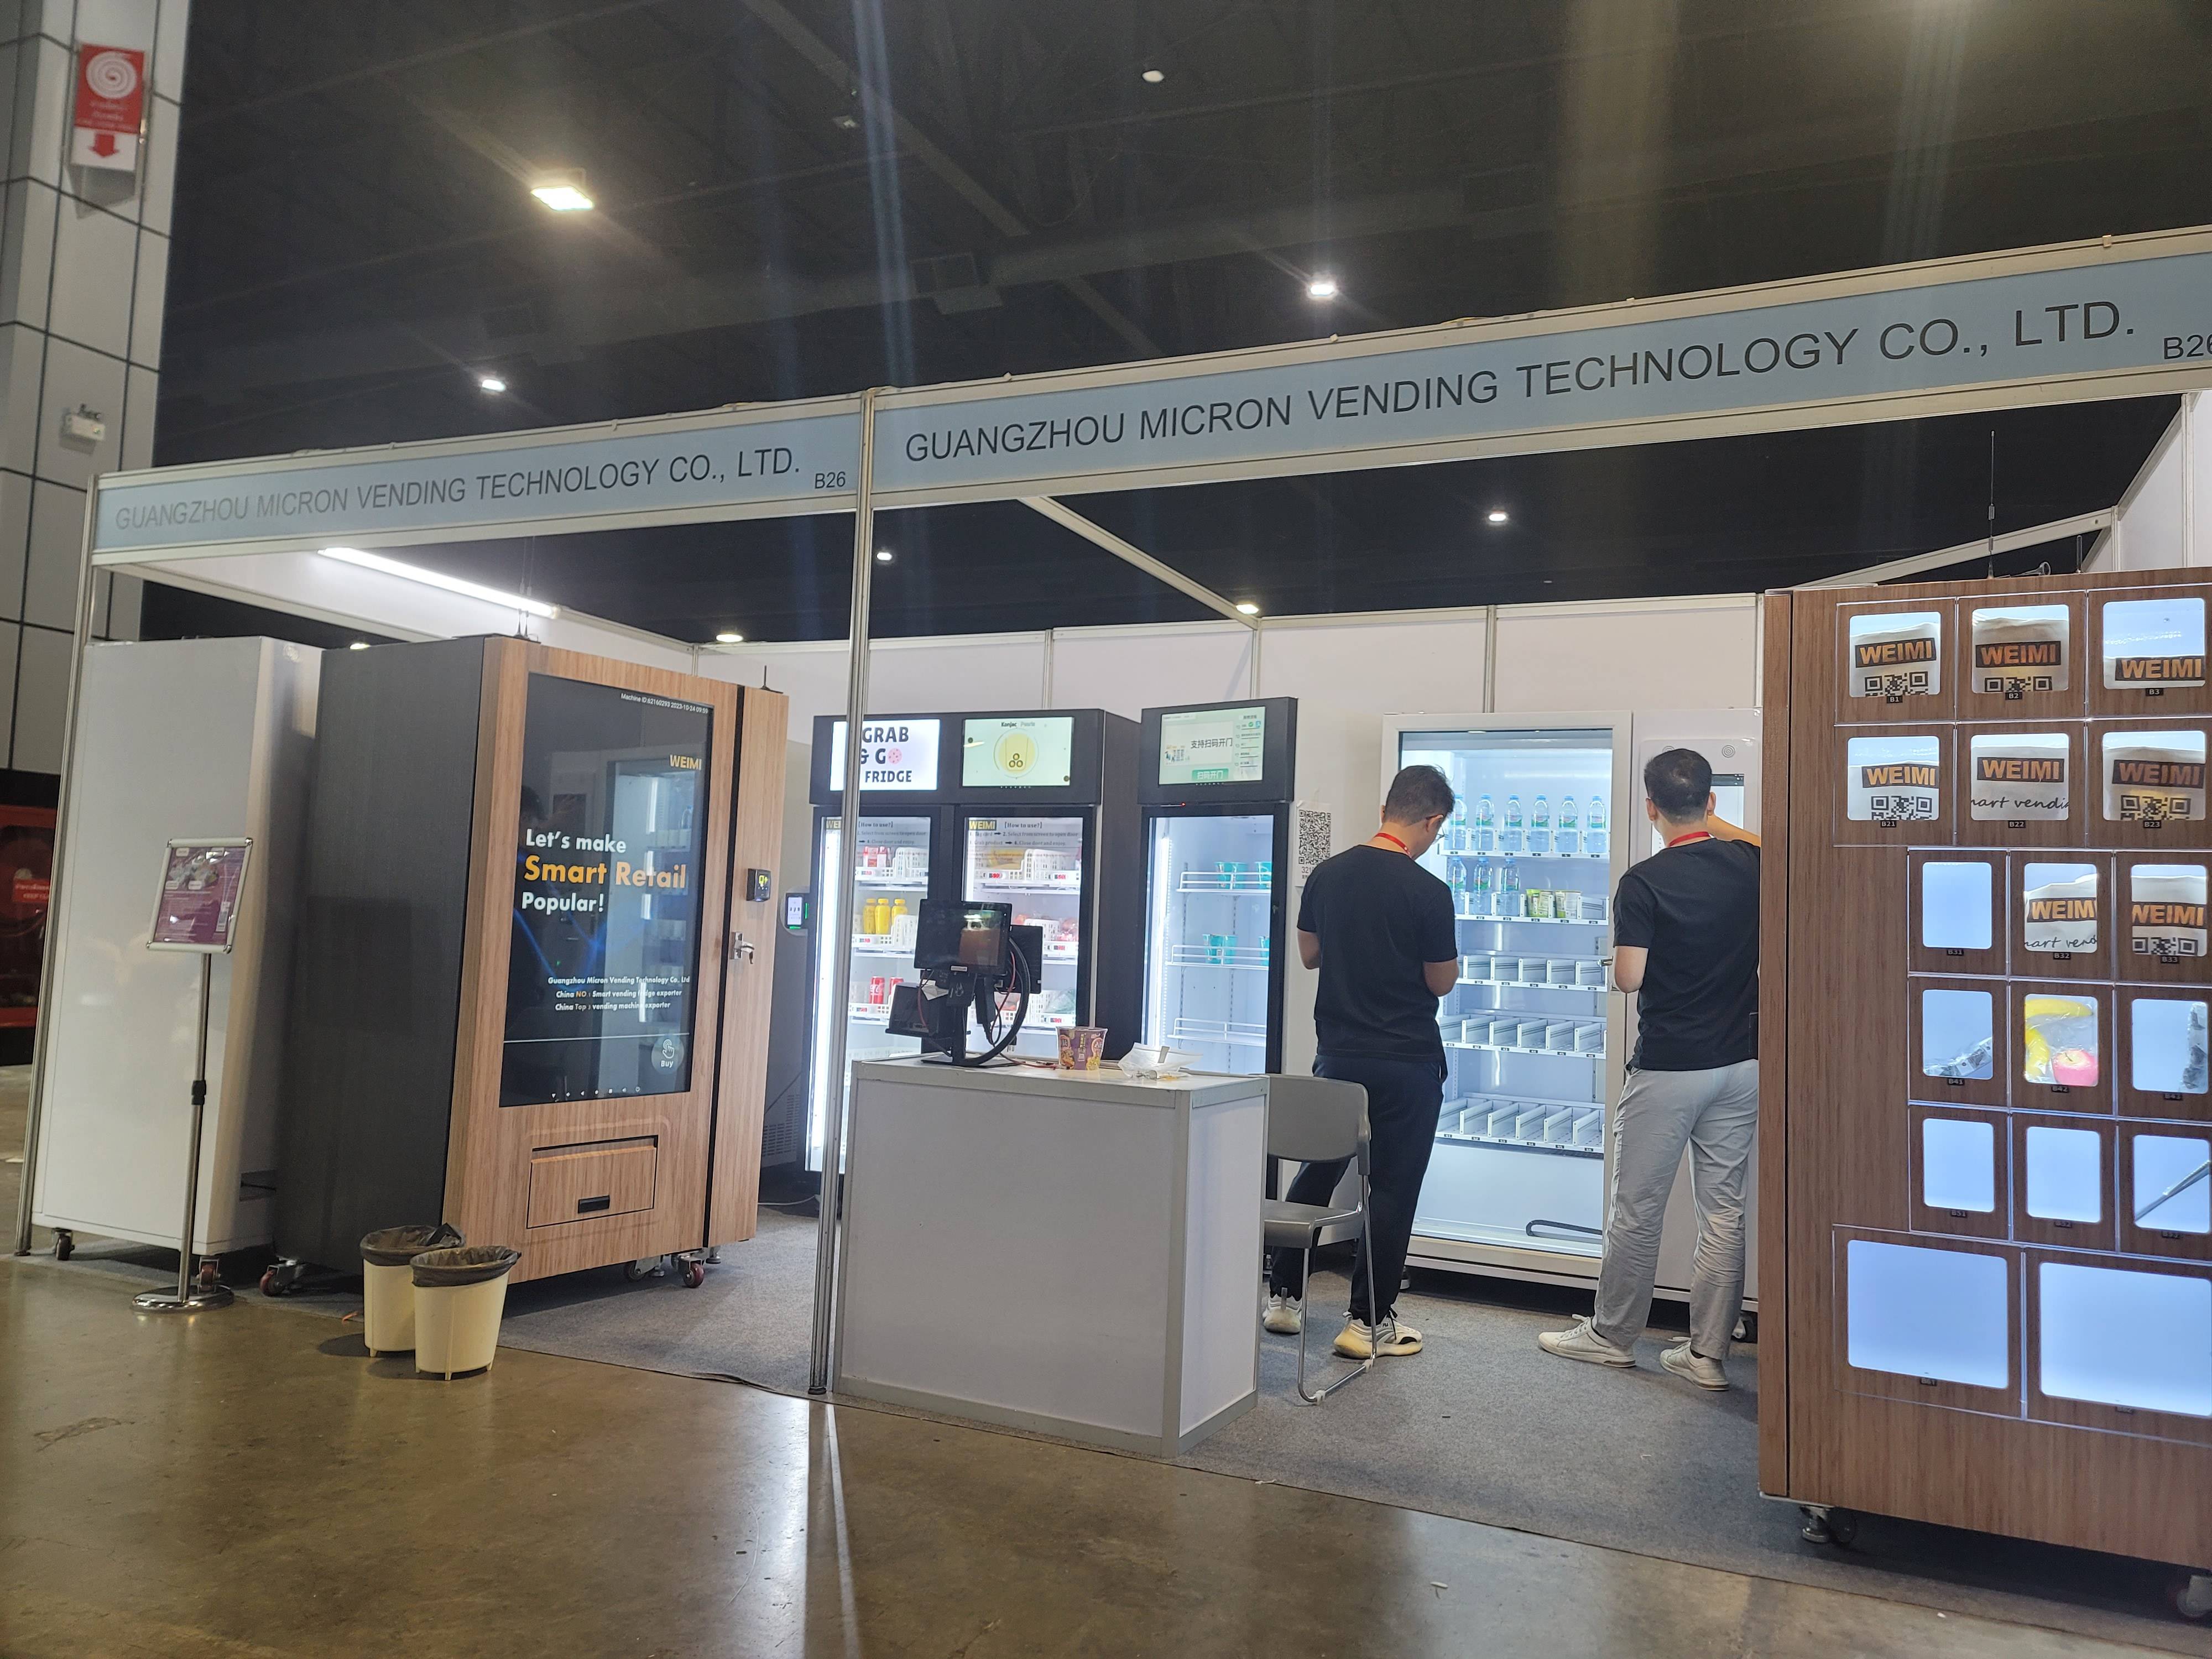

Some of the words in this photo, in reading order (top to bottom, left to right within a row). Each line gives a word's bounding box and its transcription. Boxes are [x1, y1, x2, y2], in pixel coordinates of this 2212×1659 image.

[906, 413, 1124, 462] GUANGZHOU
[1140, 395, 1290, 440] MICRON
[1308, 371, 1498, 420] VENDING
[1516, 328, 1859, 398] TECHNOLOGY
[1880, 319, 1989, 360] CO.,
[2015, 301, 2135, 346] LTD.
[115, 495, 249, 530] GUANGZHOU
[257, 487, 349, 518] MICRON
[357, 477, 466, 509] VENDING
[476, 458, 660, 500] TECHNOLOGY
[669, 455, 725, 483] CO.,
[738, 447, 800, 477] LTD.
[815, 471, 846, 489] B26
[1860, 640, 1932, 665] WEIMI
[1980, 644, 2056, 665] WEIMI
[2121, 659, 2201, 679] WEIMI
[620, 693, 641, 702] Machine
[862, 726, 909, 743] GRAB
[1190, 737, 1233, 749] 支持扫码开门
[670, 755, 702, 770] WEIMI
[1983, 759, 2060, 780] WEIMI
[864, 770, 912, 782] FRIDGE
[1867, 766, 1936, 786] WEIMI
[2119, 762, 2200, 785] WEIMI
[969, 821, 995, 830] WEIMI
[576, 834, 627, 854] make
[524, 855, 607, 885] Smart
[615, 863, 686, 889] Retail
[521, 892, 605, 915] Popular!
[548, 976, 586, 985] Guangzhou
[609, 976, 635, 985] Vending
[636, 976, 669, 985] Technology
[612, 990, 637, 998] vending
[575, 1003, 587, 1011] Top
[592, 1002, 617, 1011] vending
[660, 1060, 674, 1068] Buy
